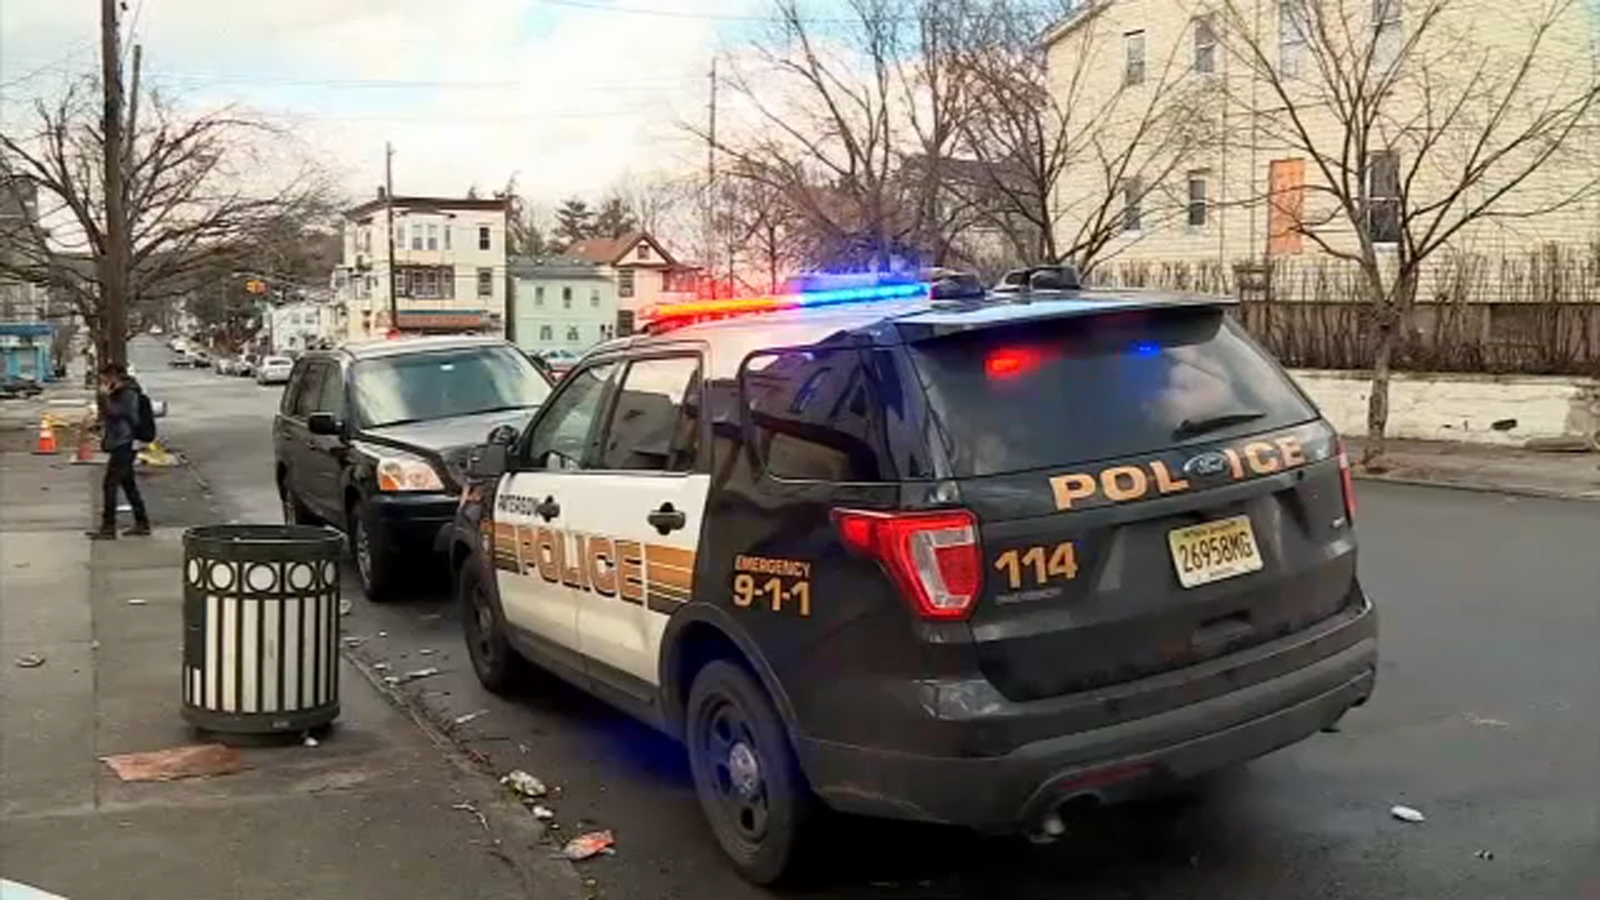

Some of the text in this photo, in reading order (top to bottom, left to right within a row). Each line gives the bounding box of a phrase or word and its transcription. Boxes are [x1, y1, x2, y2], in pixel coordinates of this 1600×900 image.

[516, 523, 646, 606] POLICE
[734, 554, 811, 578] EMERGENCY
[994, 541, 1079, 589] 114
[1180, 531, 1253, 573] 26958MG
[733, 574, 810, 616] 9-1-1
